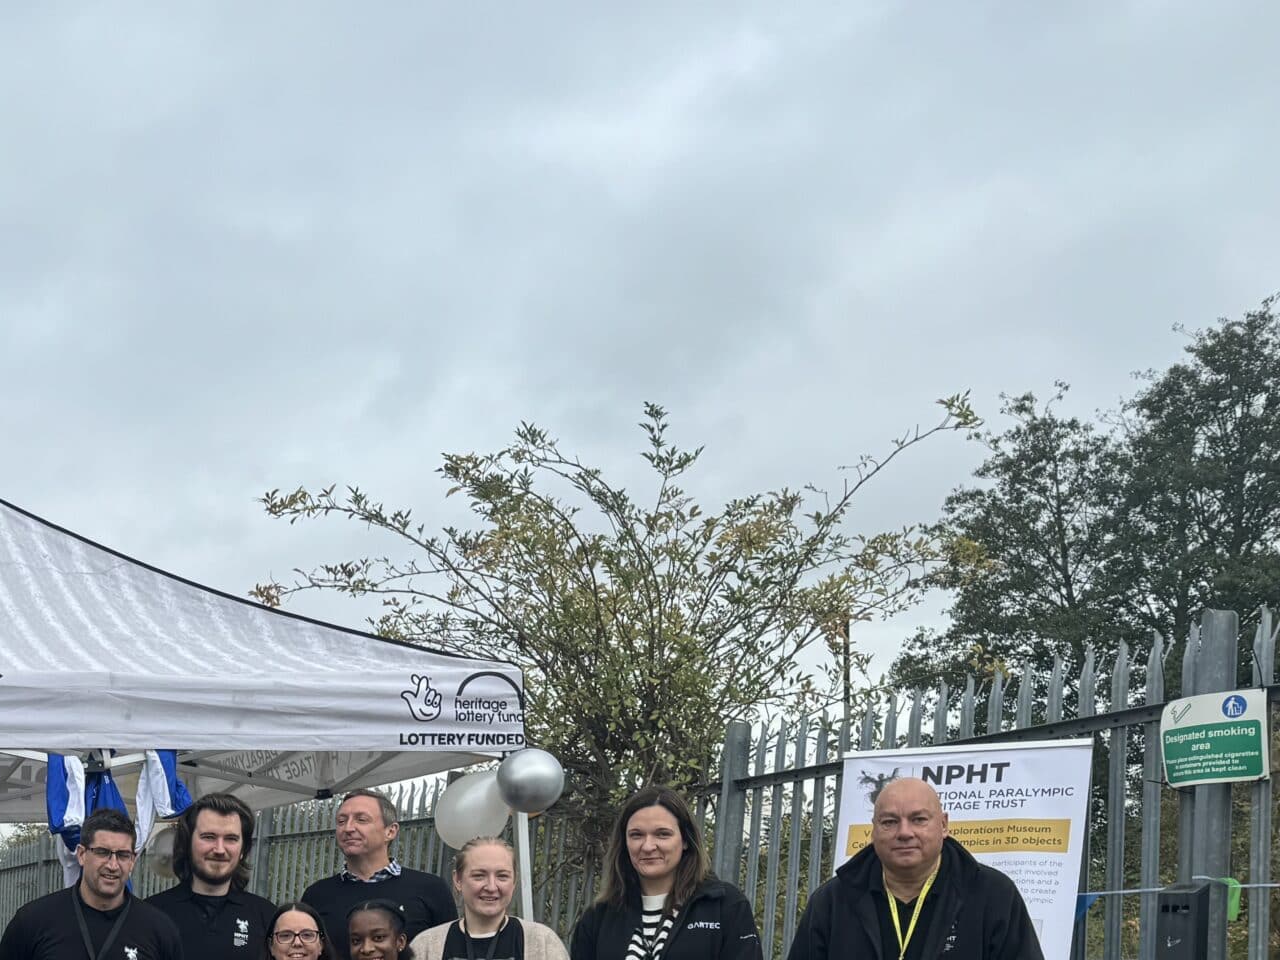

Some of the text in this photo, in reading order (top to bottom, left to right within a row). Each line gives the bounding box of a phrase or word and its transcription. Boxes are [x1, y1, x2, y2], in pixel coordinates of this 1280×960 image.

[455, 697, 508, 712] heritage
[455, 711, 494, 725] lottery
[399, 733, 524, 745] LOTTERY FUNDED
[1165, 726, 1256, 744] Designated smoking
[1191, 742, 1211, 751] area
[922, 762, 1010, 785] NPHT
[938, 787, 1074, 800] TIONAL PARALYMPIC
[942, 799, 1026, 811] ITAGE TRUST
[1007, 824, 1052, 834] Museum
[992, 837, 1001, 845] in
[1004, 836, 1019, 845] 3D
[1022, 835, 1062, 846] objects
